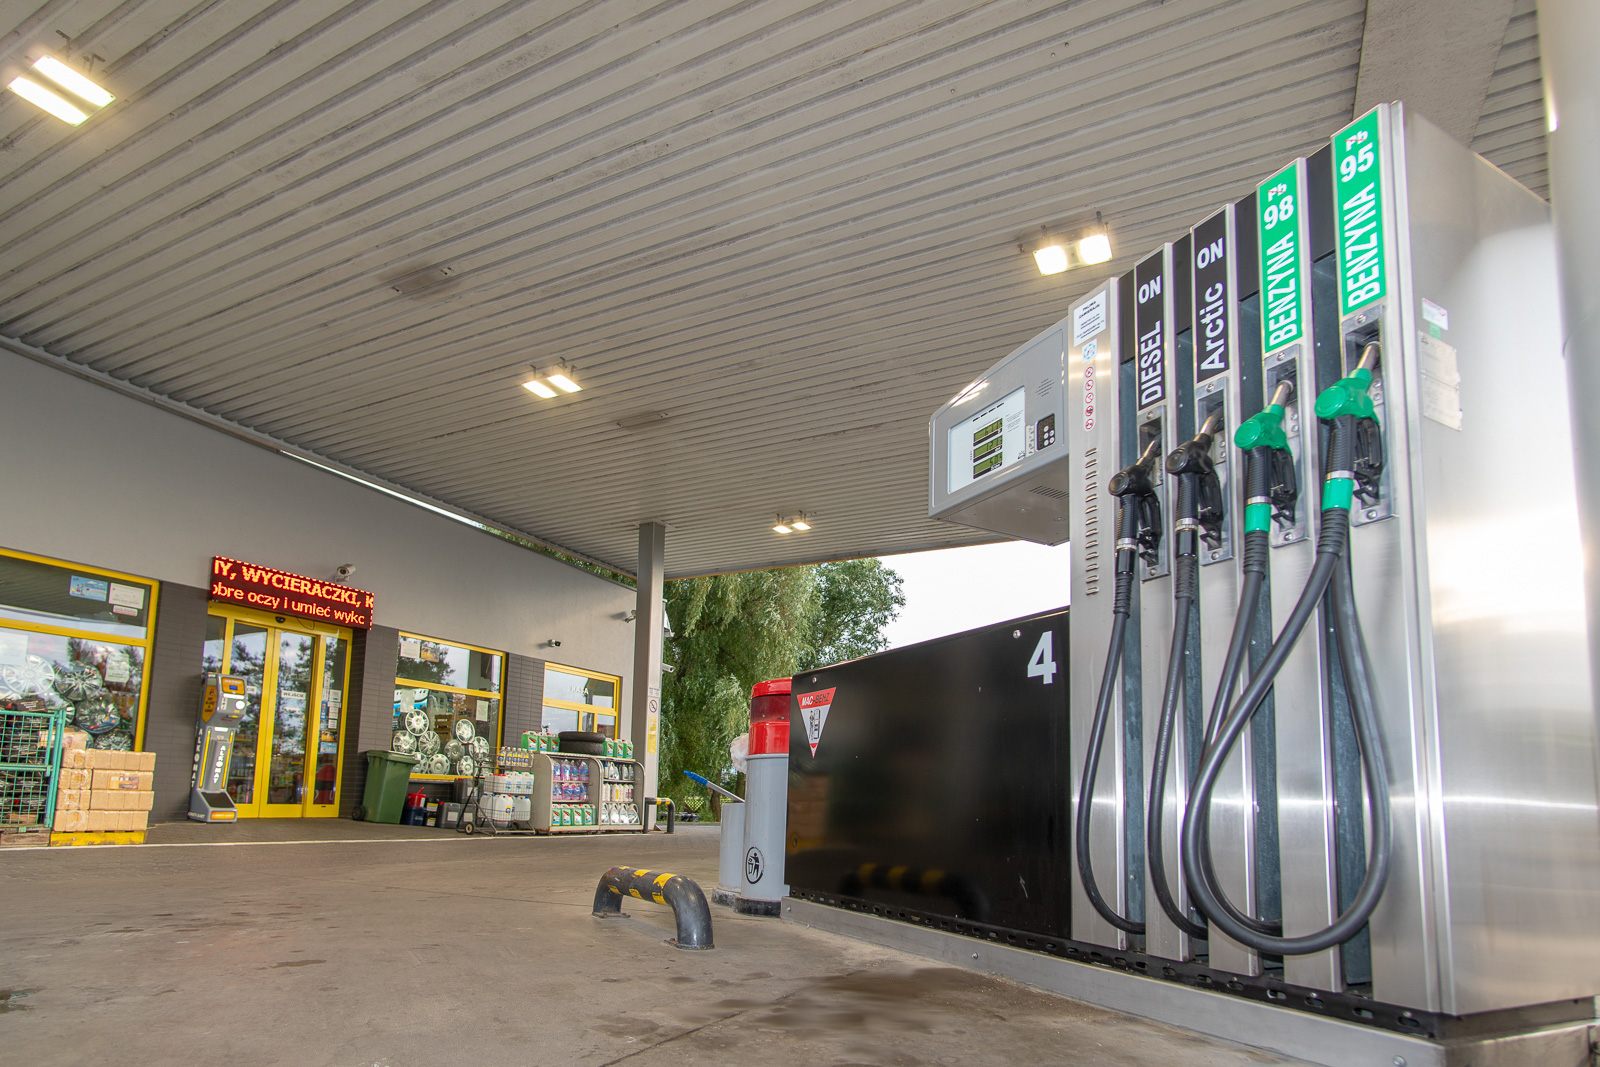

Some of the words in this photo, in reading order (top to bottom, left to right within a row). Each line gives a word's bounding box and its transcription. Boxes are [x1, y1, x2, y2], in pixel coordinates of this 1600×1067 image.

[1340, 142, 1375, 183] 95
[1263, 195, 1295, 230] 98
[1196, 237, 1225, 270] ON
[1343, 182, 1381, 308] BENZYNA
[1138, 275, 1162, 304] ON
[1266, 231, 1298, 347] BENZYNA
[1200, 282, 1226, 371] Arctic
[1140, 320, 1163, 406] DIESEL
[241, 566, 362, 608] WYCIERACZKI,
[247, 592, 281, 609] oczy
[284, 597, 288, 609] i
[291, 600, 332, 618] umieć
[1028, 631, 1057, 685] 4
[801, 693, 830, 706] MAC-BENZ
[190, 728, 203, 788] ALKOMAT
